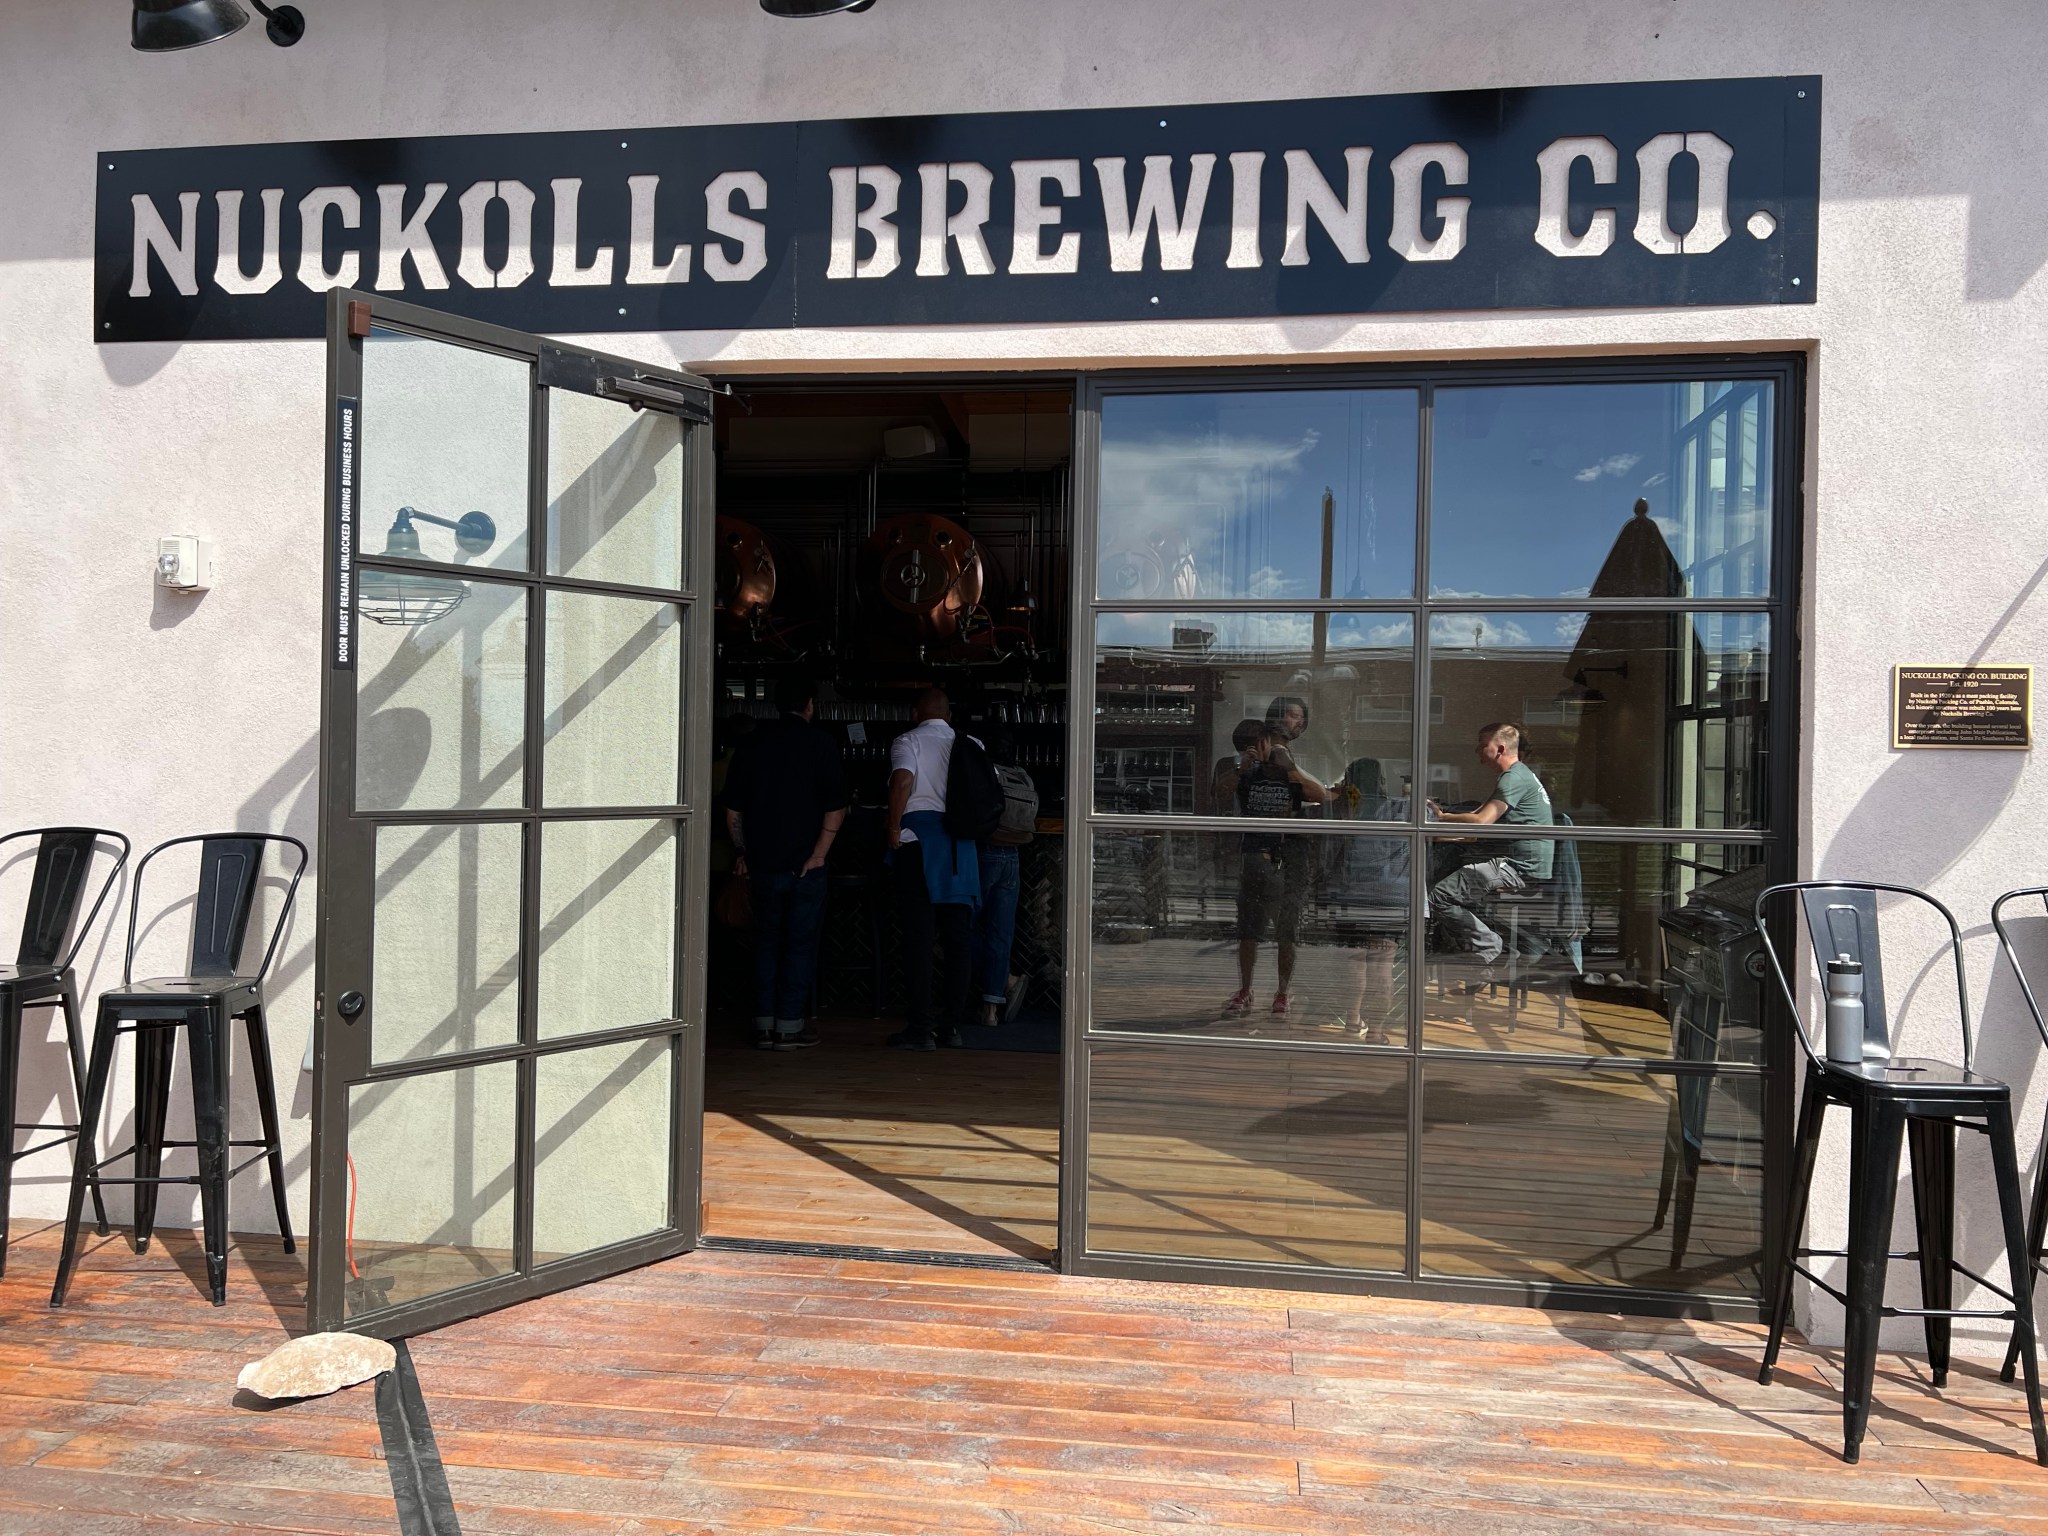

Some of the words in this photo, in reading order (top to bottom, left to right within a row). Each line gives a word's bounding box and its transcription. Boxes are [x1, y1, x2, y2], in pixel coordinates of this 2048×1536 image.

[131, 170, 767, 297] NUCKOLLS
[825, 141, 1472, 280] BREWING
[1534, 131, 1778, 258] CO.
[343, 408, 353, 440] HOURS
[342, 441, 352, 486] BUSINESS
[341, 487, 351, 522] DURING
[341, 523, 350, 570] UNLOCKED
[340, 572, 350, 607] REMAIN
[339, 609, 349, 635] MUST
[339, 637, 349, 662] DOOR
[1943, 672, 1976, 680] PACKING
[1976, 672, 1989, 680] CO.
[1963, 680, 1979, 688] 1920
